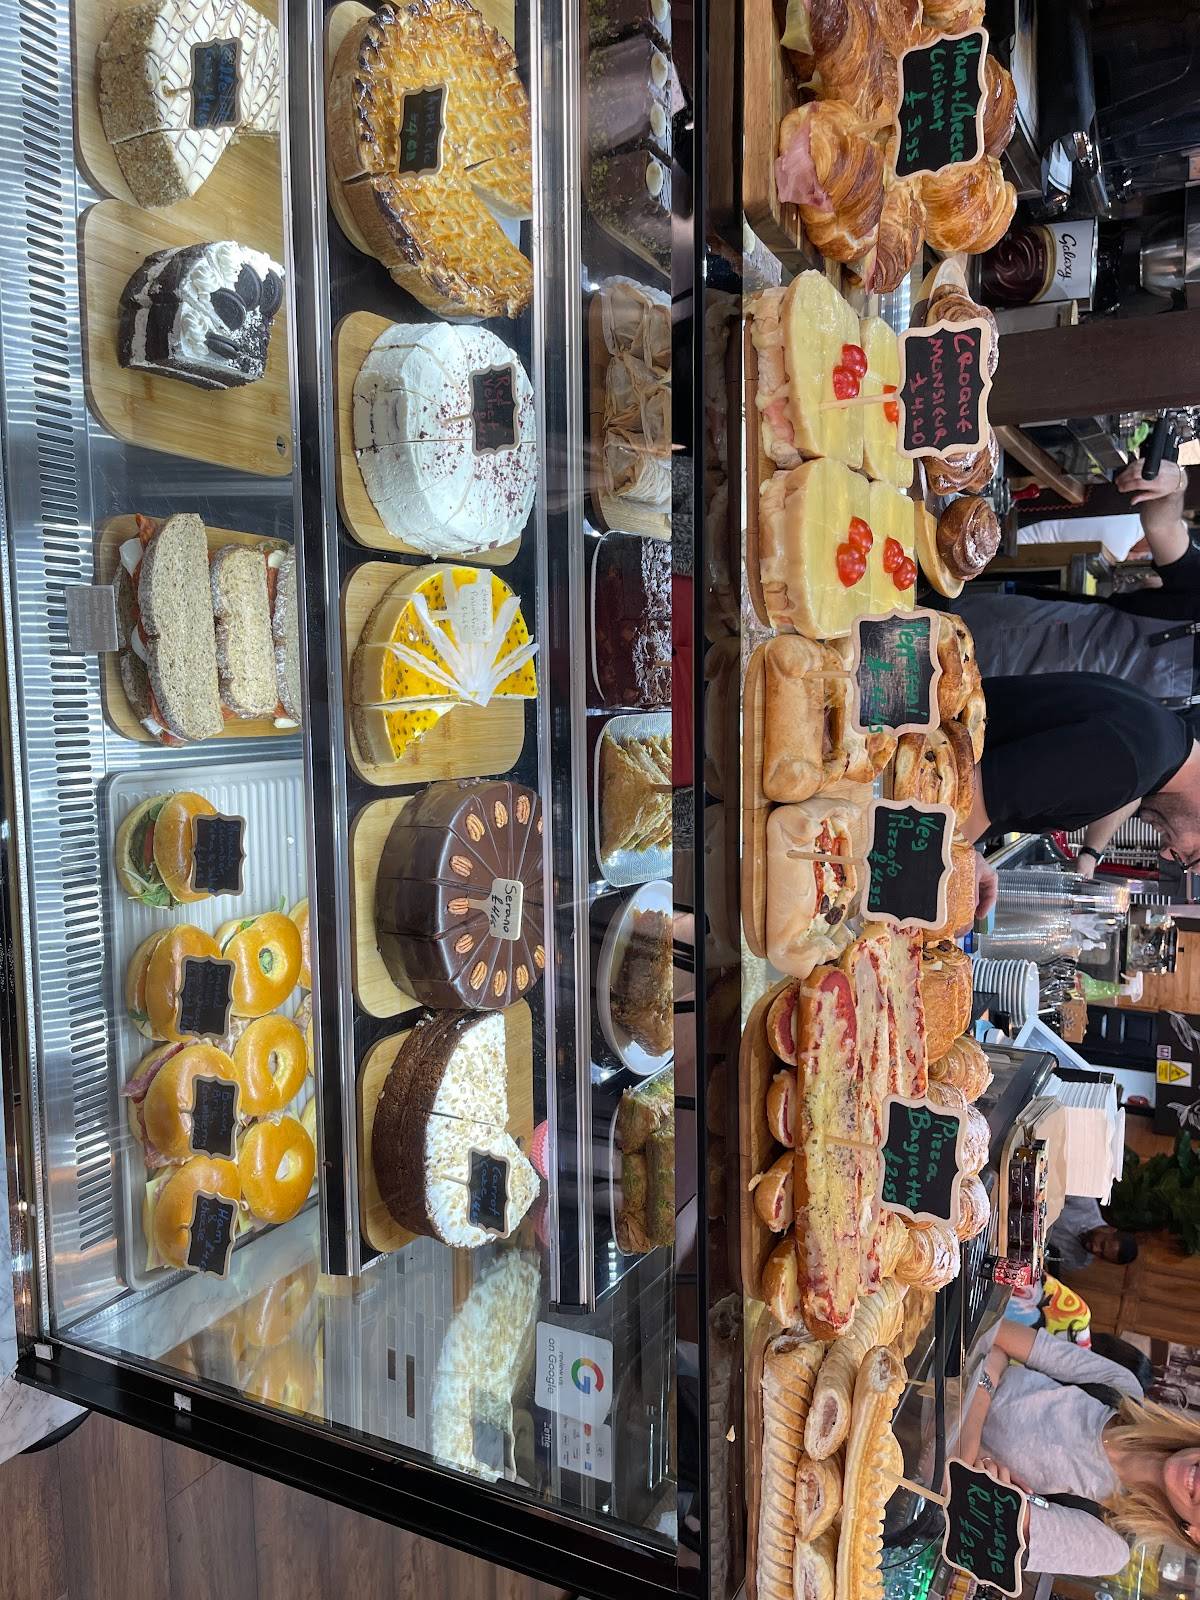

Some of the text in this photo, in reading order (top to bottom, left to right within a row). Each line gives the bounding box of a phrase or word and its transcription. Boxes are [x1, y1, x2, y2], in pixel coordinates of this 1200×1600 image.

[952, 40, 980, 87] Ham
[424, 95, 440, 137] Apple
[950, 103, 977, 162] Cheese
[1057, 233, 1077, 280] Galaxy
[495, 375, 512, 407] Red
[953, 334, 975, 433] CROQUE
[911, 816, 940, 852] Veg
[503, 884, 517, 933] Serano
[903, 1107, 932, 1208] Baguette
[926, 1120, 958, 1183] Pizza
[488, 1166, 502, 1216] Carrot
[214, 1208, 230, 1244] Ham
[545, 1338, 557, 1394] on Google
[967, 1484, 991, 1525] Roll
